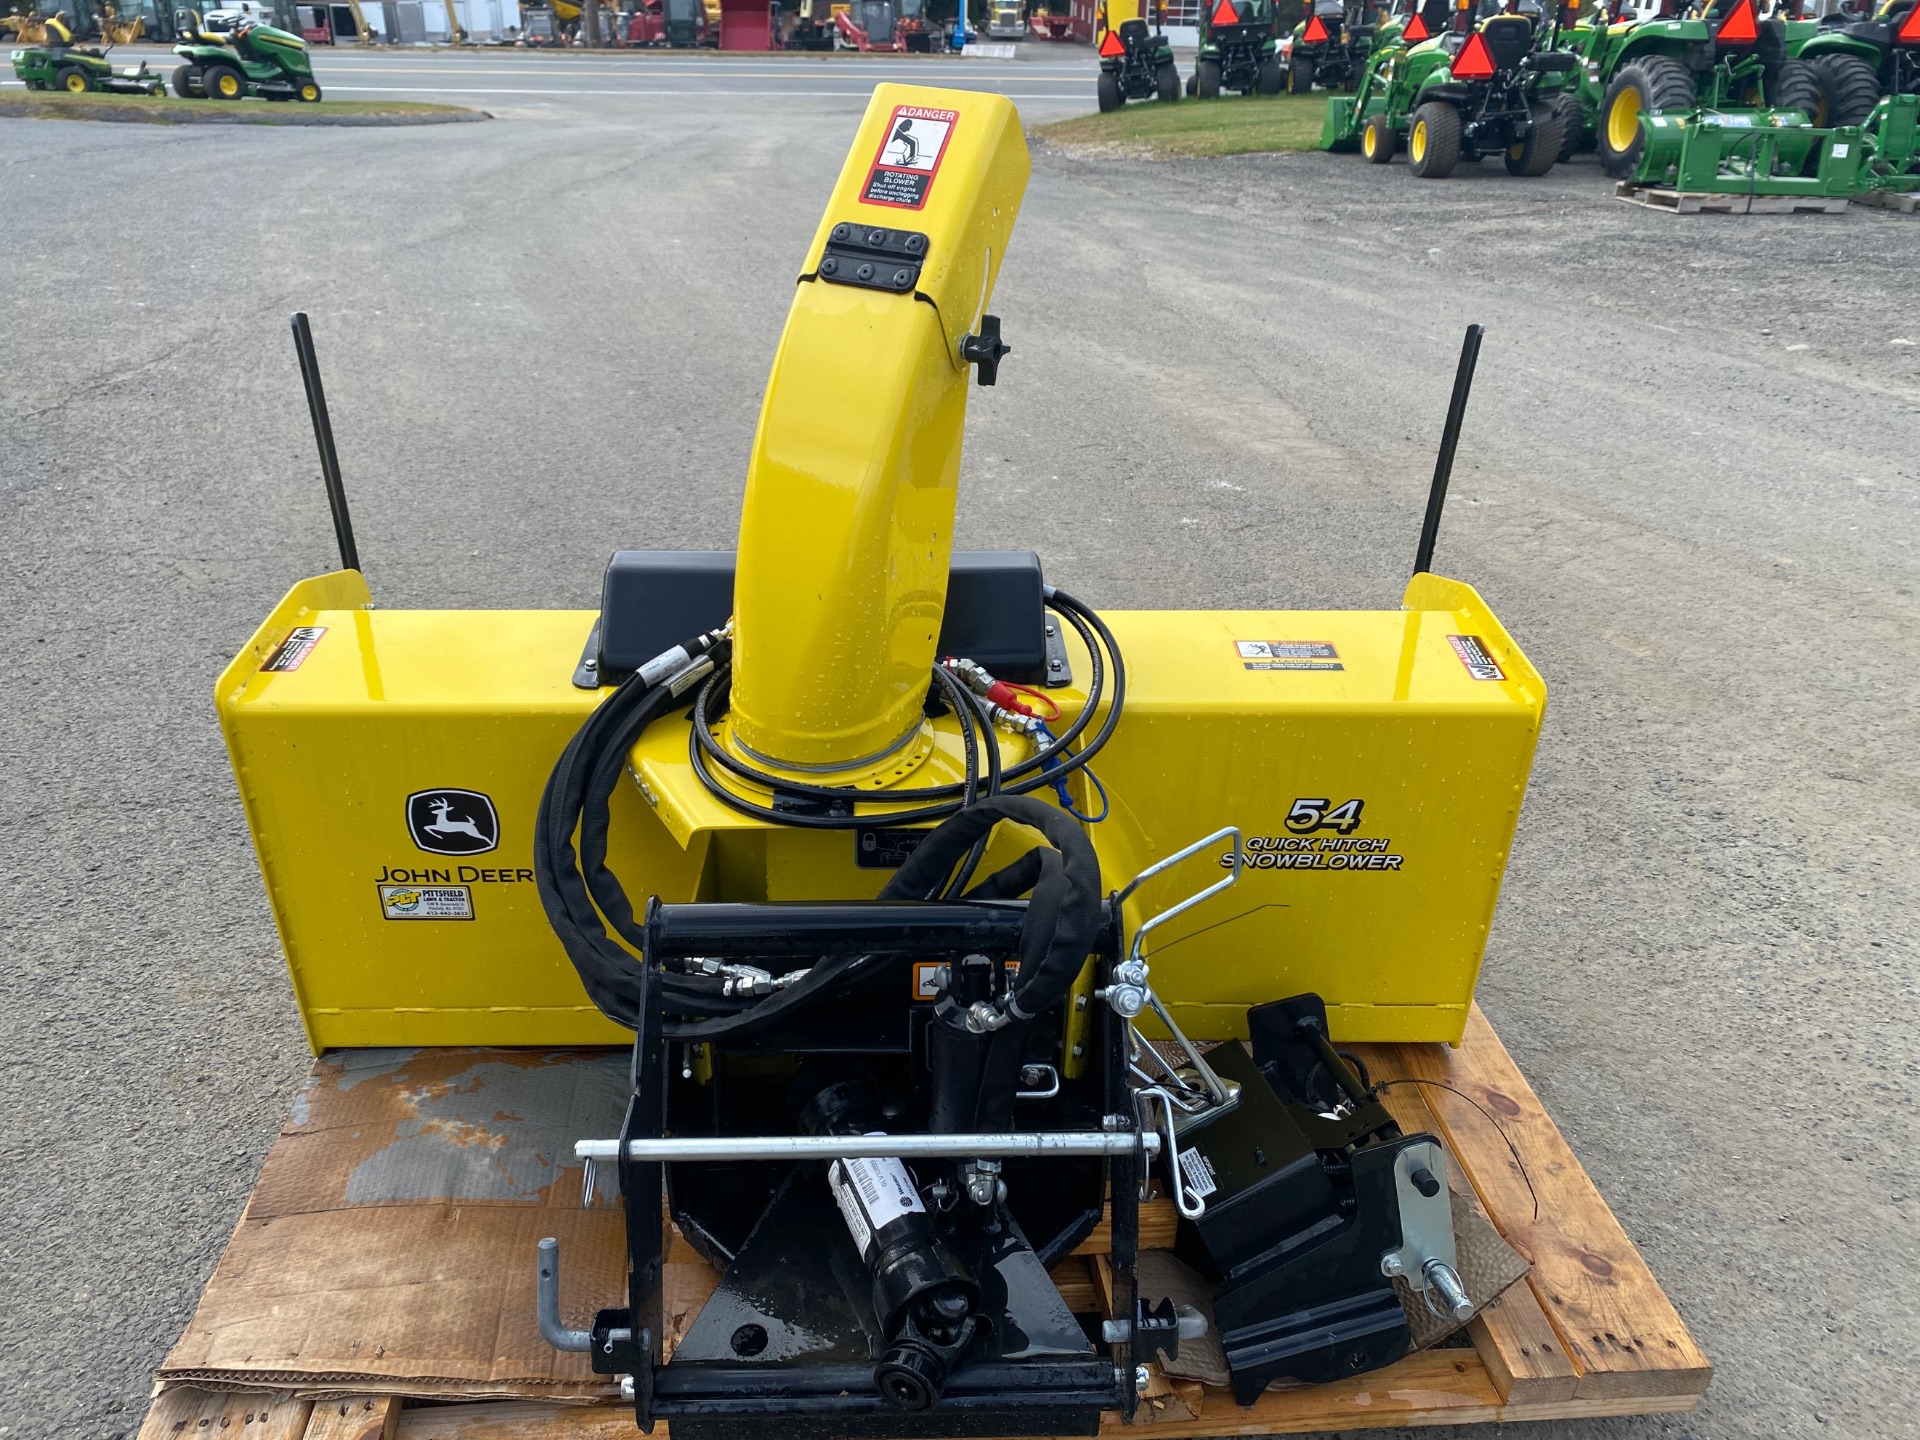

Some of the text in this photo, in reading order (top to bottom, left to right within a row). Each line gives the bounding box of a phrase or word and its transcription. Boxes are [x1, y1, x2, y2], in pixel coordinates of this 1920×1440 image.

[907, 107, 955, 121] DANGER
[884, 171, 919, 181] ROTATING
[884, 177, 915, 186] BLOWER
[868, 193, 895, 202] discharge
[889, 190, 919, 199] unclogging
[1284, 798, 1365, 835] 54
[1246, 837, 1390, 853] QUICK HITCH
[1219, 853, 1404, 871] SNOWBLOWER
[375, 865, 535, 883] JOHN DEER
[387, 891, 421, 907] PLT
